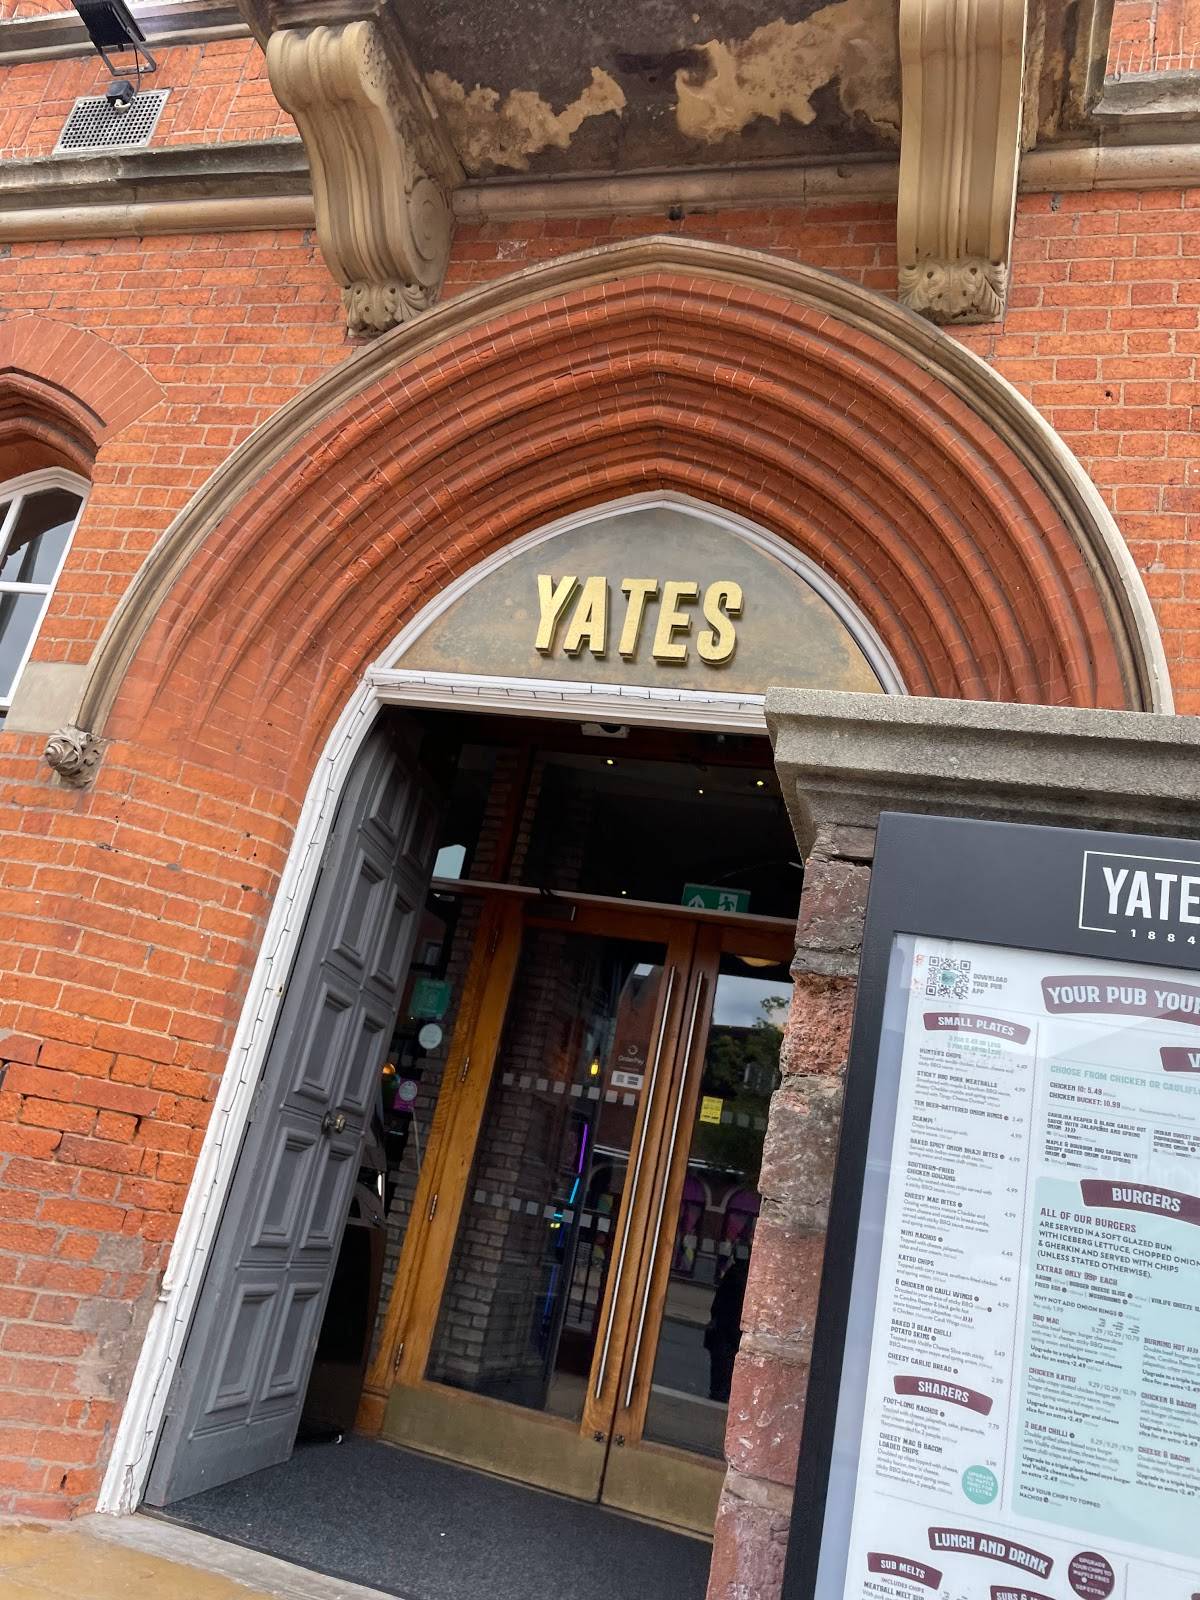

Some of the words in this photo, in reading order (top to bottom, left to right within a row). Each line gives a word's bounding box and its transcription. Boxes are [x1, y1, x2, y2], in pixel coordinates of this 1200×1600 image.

[535, 575, 743, 664] YATES
[973, 973, 1008, 983] DOWNLOAD
[1044, 985, 1101, 1003] YOUR
[1106, 986, 1146, 1005] PUB
[938, 1017, 973, 1027] SMALL
[976, 1019, 1015, 1036] PLATES
[965, 1078, 997, 1088] MEATBALLS
[1051, 1065, 1081, 1076] CHOOSE
[1084, 1071, 1107, 1080] FROM
[1110, 1074, 1146, 1086] CHICKEN
[1050, 1082, 1076, 1091] CHICKEN
[1050, 1092, 1075, 1101] CHICKEN
[926, 1101, 968, 1114] BEER-BATTERED
[910, 1138, 928, 1146] BAKED
[947, 1144, 962, 1152] ONION
[983, 1150, 998, 1158] BITES
[907, 1168, 930, 1177] CHICKEN
[908, 1161, 955, 1174] SOUTHERN-FRIED
[904, 1192, 925, 1200] CHEESY
[1112, 1187, 1181, 1212] BURGERS
[1040, 1207, 1057, 1218] ALL
[1060, 1211, 1071, 1219] OF
[1074, 1213, 1091, 1225] OUR
[1095, 1218, 1136, 1233] BURGERS
[915, 1232, 936, 1241] NACHOS
[1040, 1221, 1054, 1229] ARE
[1056, 1223, 1083, 1235] SERVED
[1102, 1232, 1121, 1243] SOFT
[1123, 1236, 1153, 1248] GLAZED
[1155, 1242, 1172, 1251] BUN
[1039, 1230, 1058, 1240] WITH
[1060, 1234, 1093, 1246] ICEBERG
[1133, 1249, 1171, 1261] CHOPPED
[898, 1254, 916, 1262] KATSU
[918, 1257, 934, 1266] CHIPS
[1038, 1250, 1070, 1262] (UNLESS
[1071, 1255, 1100, 1268] STATED
[1045, 1241, 1080, 1253] GHERKIN
[1082, 1248, 1098, 1257] AND
[1100, 1252, 1130, 1264] SERVED
[1132, 1258, 1152, 1268] WITH
[1154, 1263, 1179, 1273] CHIPS
[1036, 1264, 1063, 1275] EXTRAS
[1065, 1269, 1082, 1279] ONLY
[1100, 1277, 1118, 1286] EACH
[901, 1280, 925, 1291] CHICKEN
[934, 1287, 951, 1296] CAULI
[953, 1292, 973, 1301] WINGS
[1034, 1294, 1047, 1302] WHY
[1076, 1302, 1098, 1312] ONION
[891, 1327, 912, 1337] POTATO
[913, 1332, 930, 1340] SKINS
[892, 1319, 910, 1328] BAKED
[917, 1325, 932, 1333] BEAN
[888, 1352, 909, 1363] CHEESY
[911, 1358, 931, 1368] GARLIC
[933, 1362, 952, 1372] BREAD
[918, 1381, 969, 1403] SHARERS
[883, 1397, 914, 1410] FOOT-LONG
[1030, 1423, 1047, 1432] BEAN
[1048, 1427, 1068, 1438] CHILLI
[878, 1440, 900, 1451] LOADED
[902, 1446, 919, 1455] CHIPS
[880, 1432, 901, 1443] CHEESY
[903, 1437, 916, 1447] MAC
[924, 1442, 942, 1453] BACON
[934, 1533, 975, 1550] LUNCH
[979, 1539, 1005, 1557] AND
[1009, 1547, 1048, 1575] DRINK
[880, 1559, 897, 1570] SUB
[899, 1563, 926, 1579] MELTS
[864, 1580, 895, 1595] MEATBALL
[896, 1589, 912, 1600] MELT
[881, 1577, 907, 1589] INCLUDES
[908, 1584, 924, 1593] CHIPS
